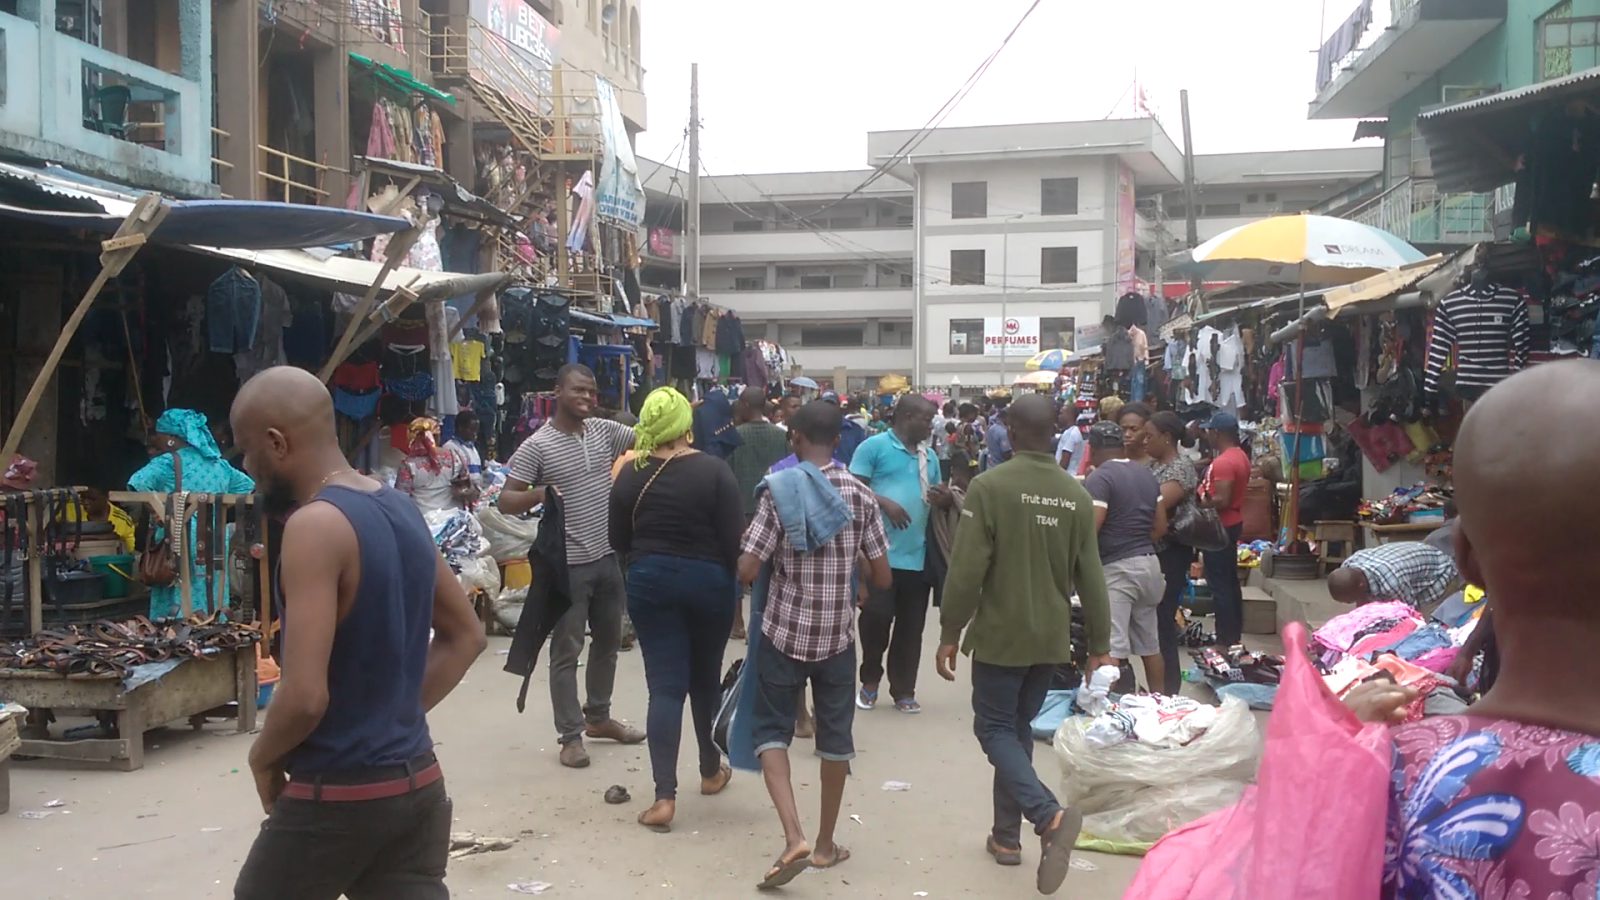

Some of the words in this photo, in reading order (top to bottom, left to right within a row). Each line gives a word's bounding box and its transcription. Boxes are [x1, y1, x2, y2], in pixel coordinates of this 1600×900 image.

[518, 5, 546, 39] BET
[1341, 244, 1384, 256] DREAM
[985, 336, 1038, 345] PERFUMES
[1021, 493, 1041, 505] Fruit
[1041, 497, 1059, 507] and
[1059, 498, 1076, 511] Veg
[1035, 515, 1059, 527] TEAM
